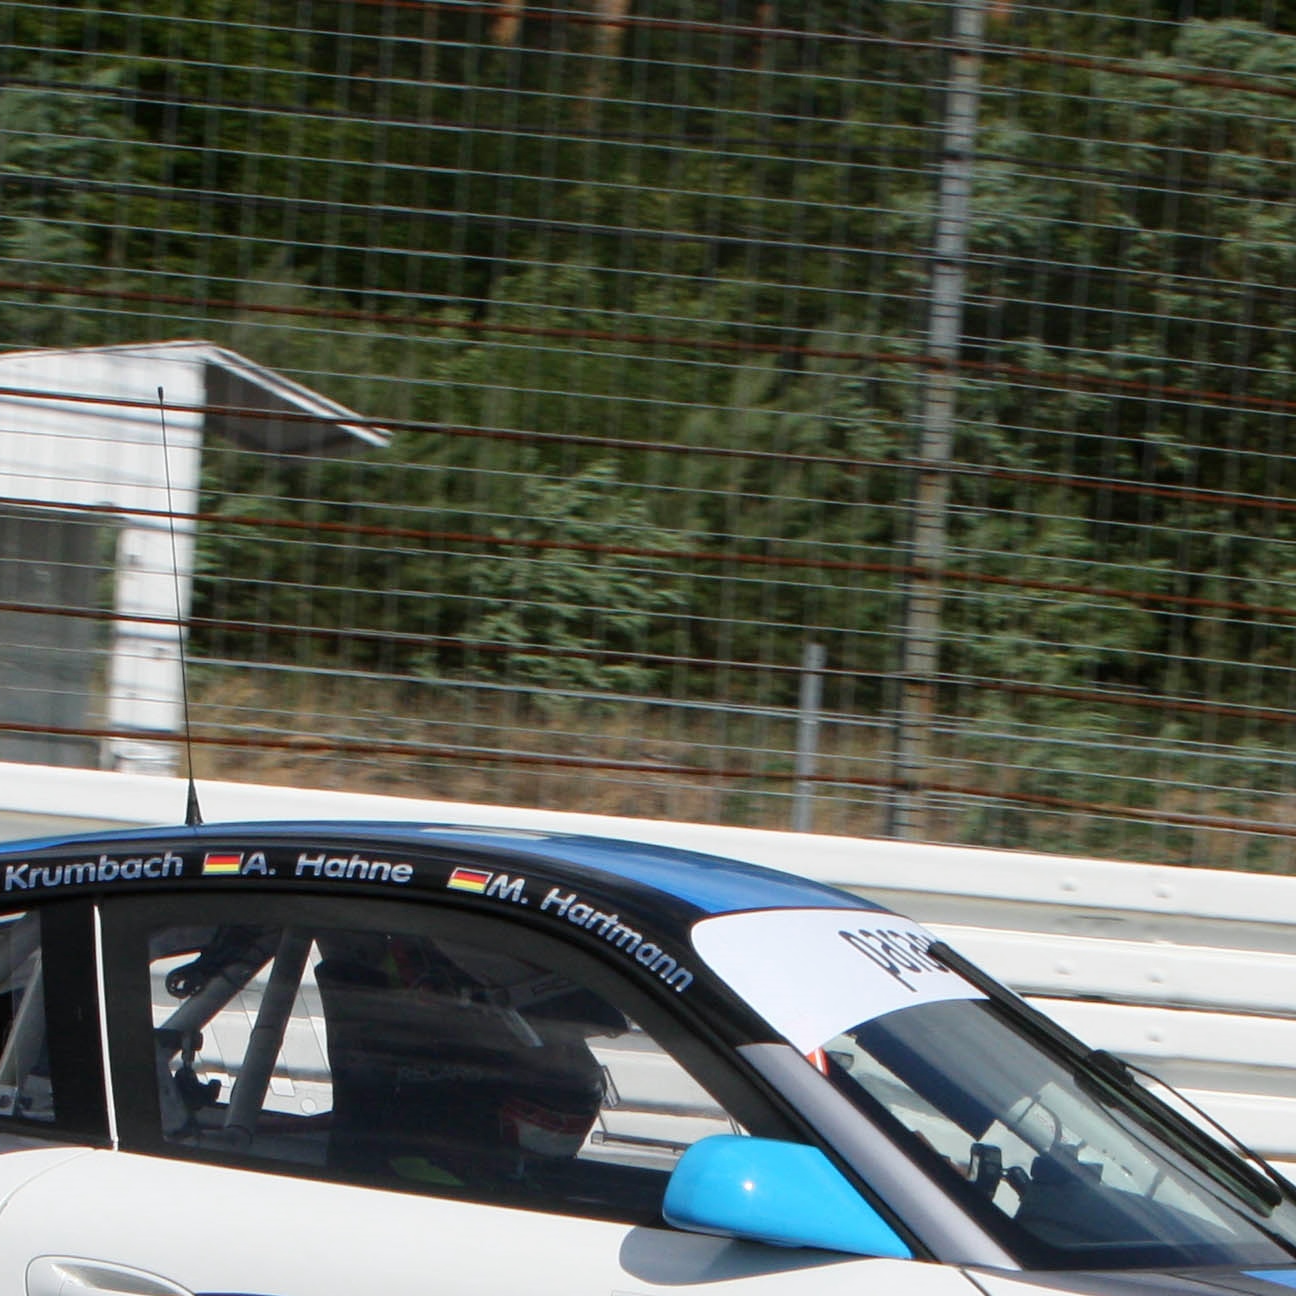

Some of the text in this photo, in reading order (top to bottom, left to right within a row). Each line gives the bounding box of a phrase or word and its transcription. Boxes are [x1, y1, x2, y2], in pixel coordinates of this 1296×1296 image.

[5, 851, 184, 891] Krumbach
[241, 852, 414, 883] A. Hahne
[486, 875, 694, 993] M. Hartmann
